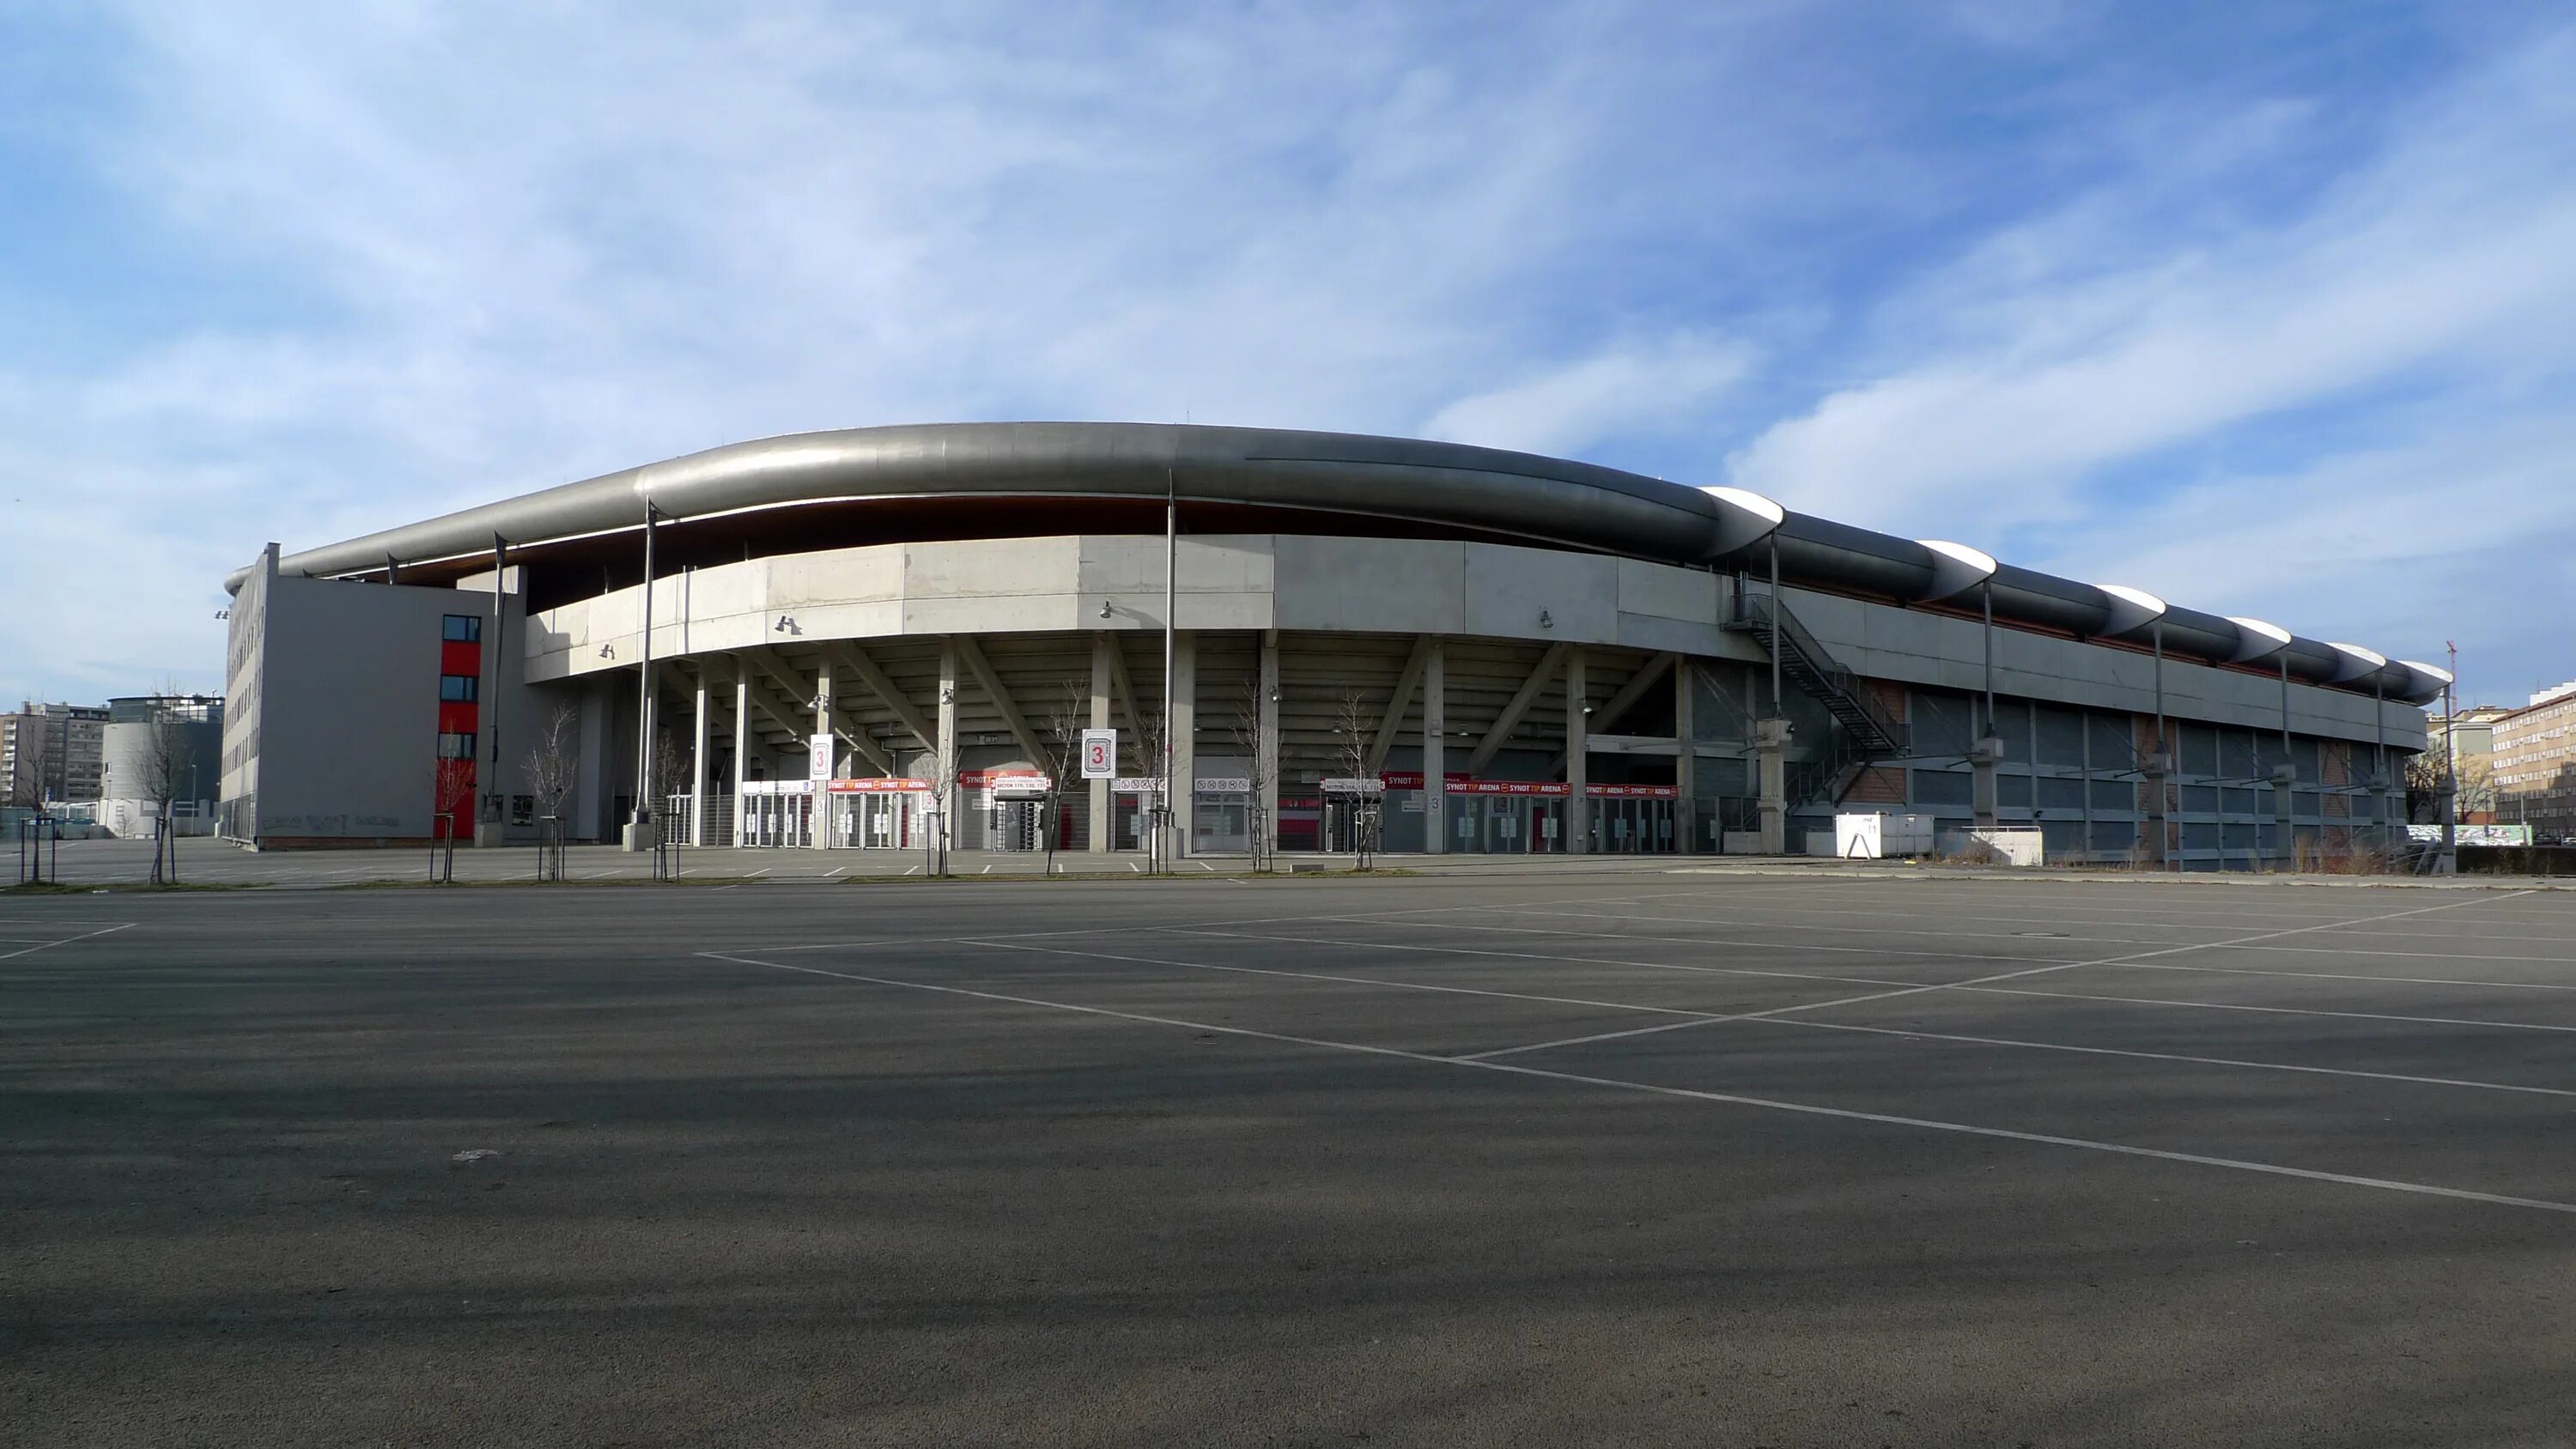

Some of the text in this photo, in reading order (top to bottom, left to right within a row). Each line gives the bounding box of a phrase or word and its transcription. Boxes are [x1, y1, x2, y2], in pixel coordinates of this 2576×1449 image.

[817, 751, 823, 767] 3
[1092, 747, 1103, 764] 3
[1320, 780, 1325, 789] 3
[927, 795, 932, 804] 3
[1431, 797, 1438, 809] 3
